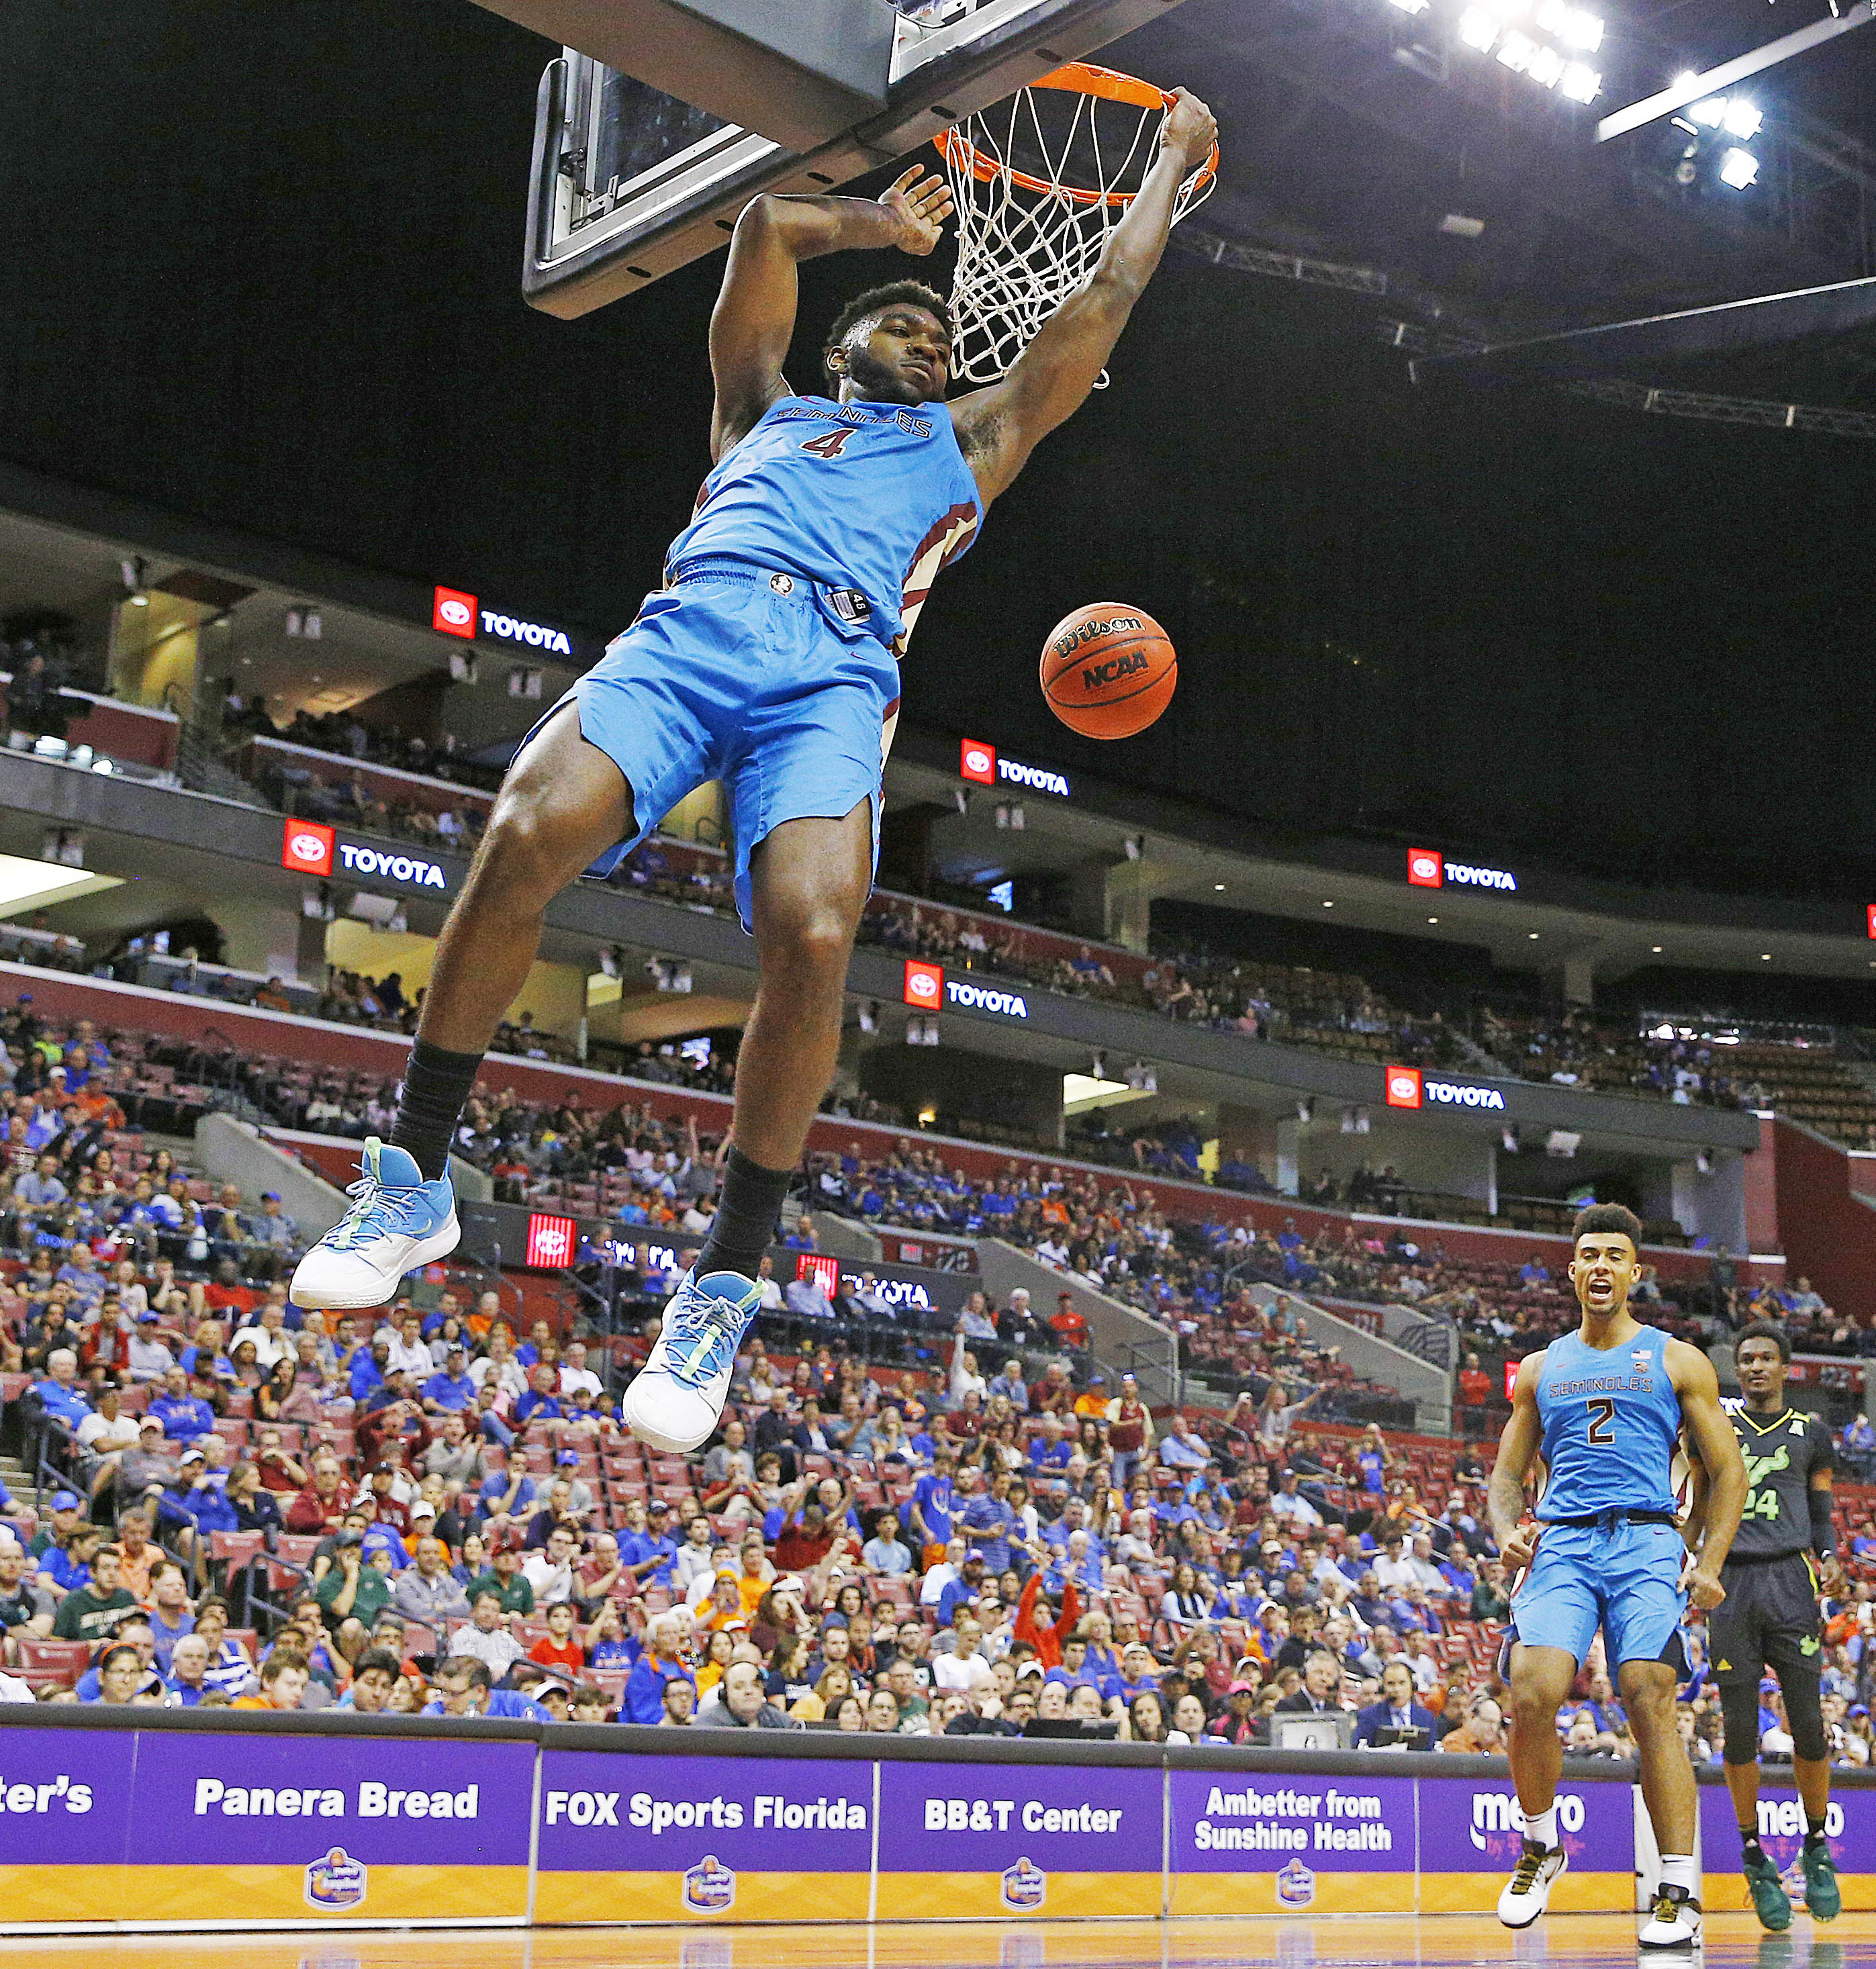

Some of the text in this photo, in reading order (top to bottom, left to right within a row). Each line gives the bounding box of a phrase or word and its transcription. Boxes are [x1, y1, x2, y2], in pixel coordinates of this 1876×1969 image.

[798, 427, 858, 460] 4
[853, 593, 866, 610] 48
[481, 610, 571, 655] TOYOTA
[1053, 617, 1146, 659] Wilson
[1082, 651, 1149, 690] NCAA
[997, 759, 1069, 796] TOYOTA
[339, 844, 446, 889] TOYOTA
[1444, 863, 1517, 891] TOYOTA
[946, 981, 1027, 1018] TOYOTA
[1425, 1082, 1505, 1110] TOYOTA
[1549, 1376, 1652, 1398] SEMINOLES
[1587, 1398, 1615, 1445] 2
[194, 1778, 479, 1819] Panera Bread
[546, 1791, 867, 1835] FOX Sports Florida
[924, 1799, 1123, 1833] BB&T Center
[1205, 1786, 1381, 1819] Ambetter from
[1470, 1792, 1586, 1838] mero
[1194, 1820, 1392, 1851] Sunshine Health
